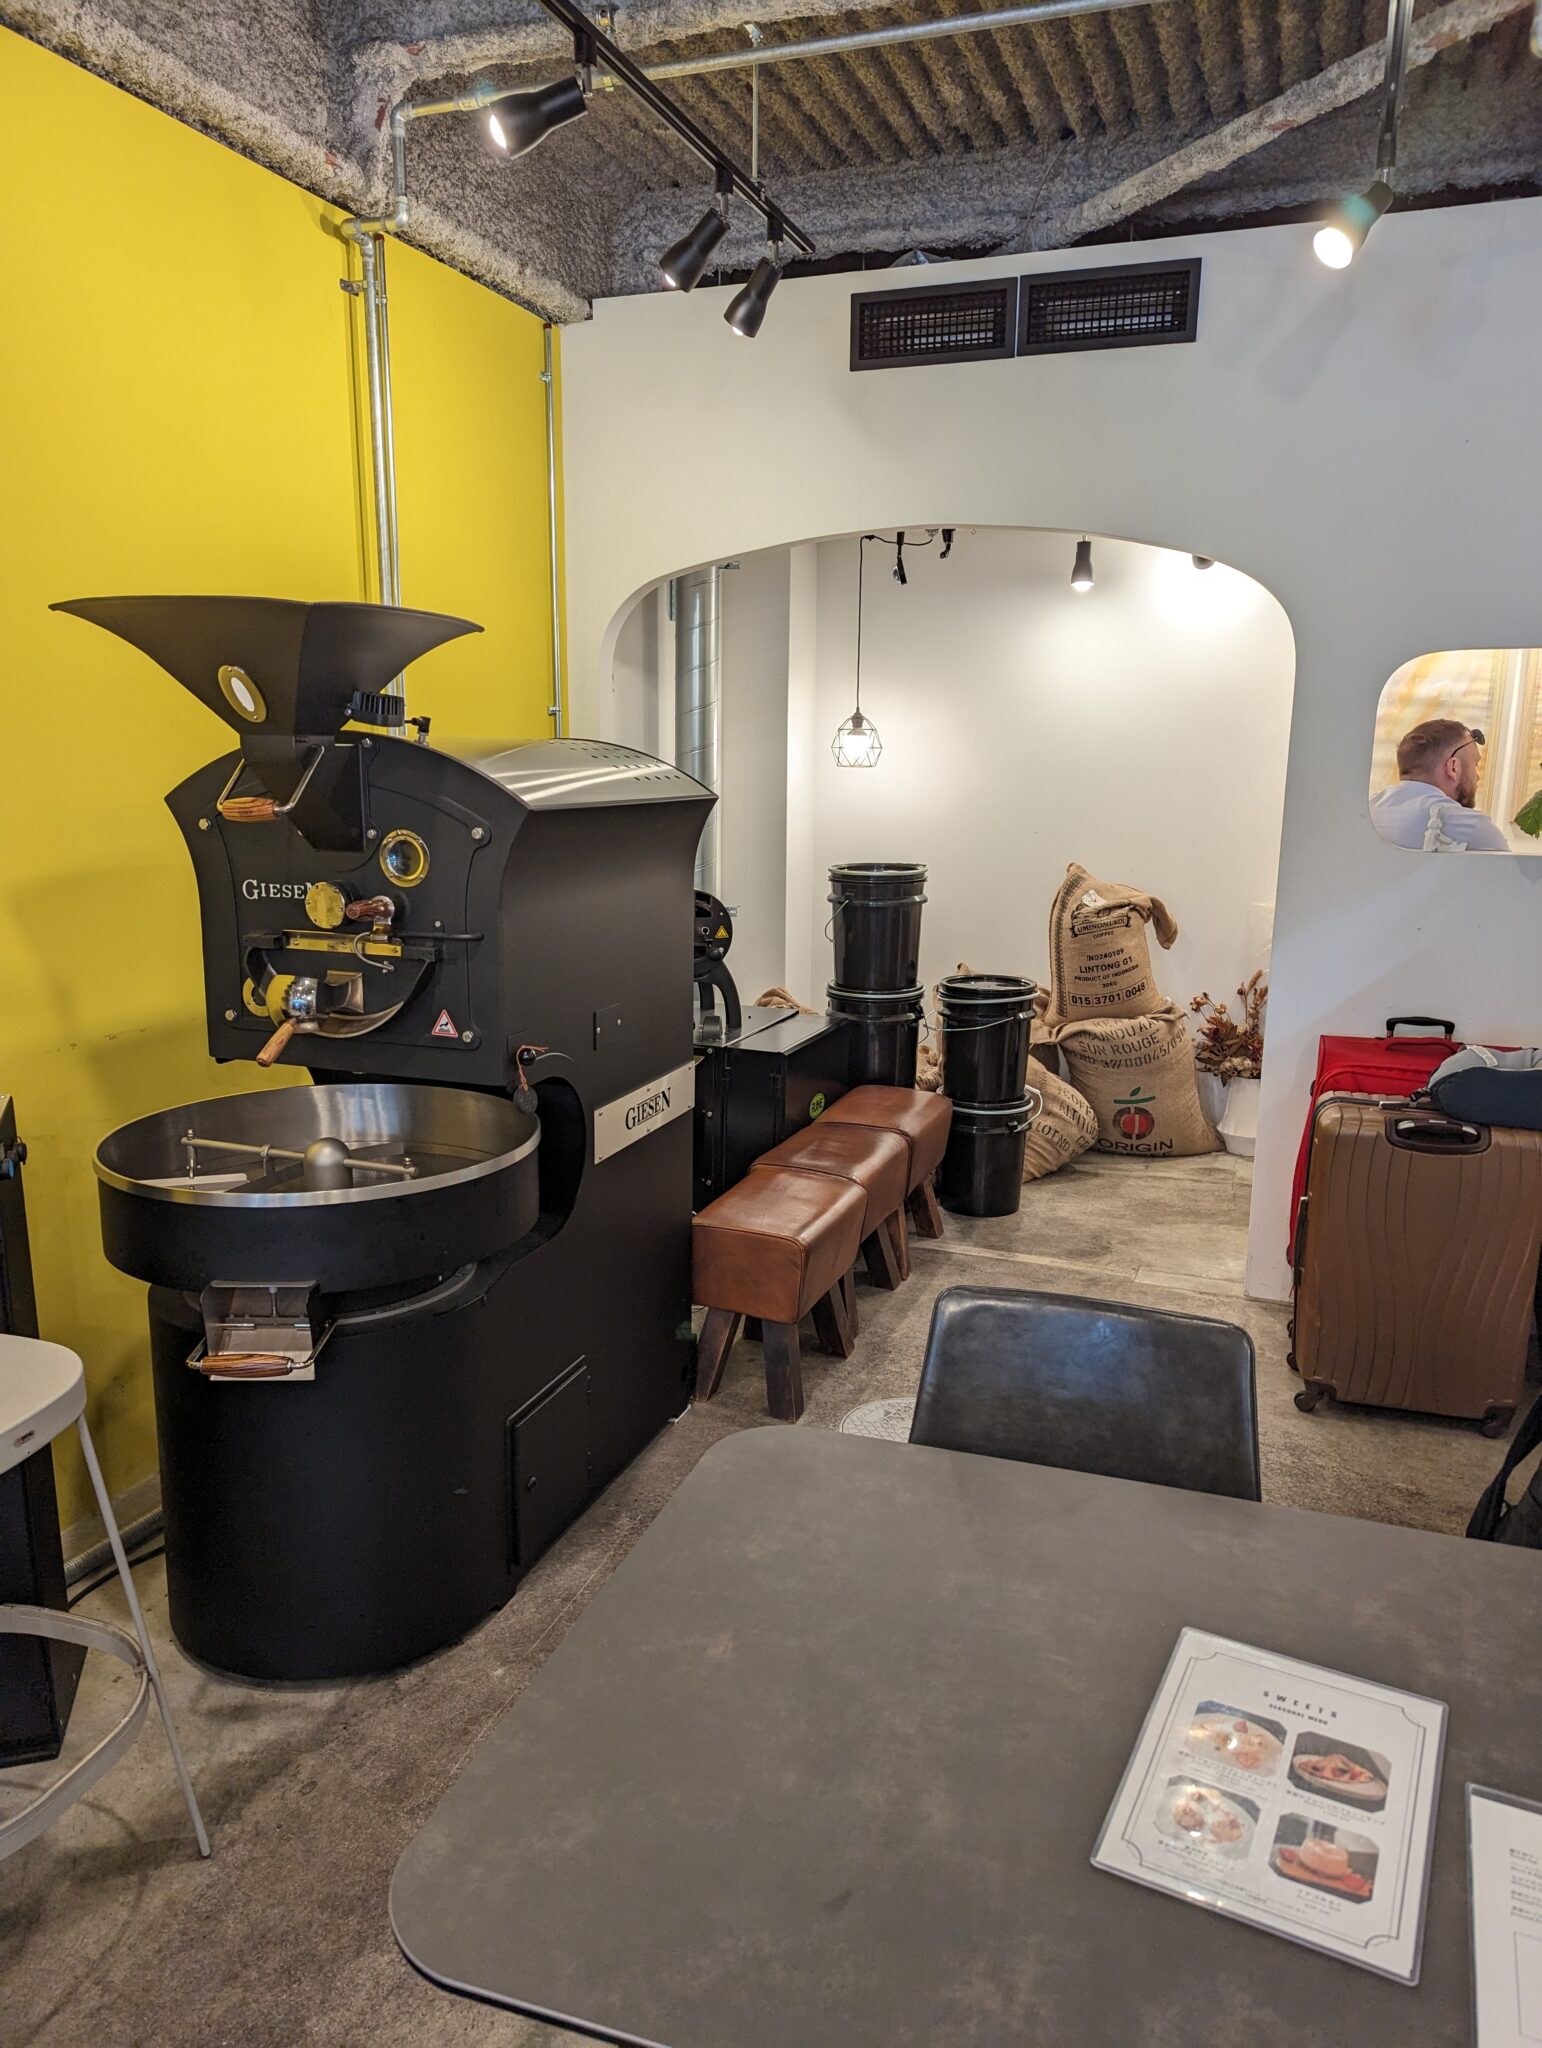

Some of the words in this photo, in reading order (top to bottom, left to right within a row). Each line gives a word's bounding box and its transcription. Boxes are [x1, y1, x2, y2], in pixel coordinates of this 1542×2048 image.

[1093, 930, 1115, 939] COFFEE
[1079, 960, 1121, 974] LINTONG
[1122, 955, 1133, 966] G1
[1111, 963, 1139, 977] INDONESIA
[1071, 995, 1092, 1005] 015
[1094, 992, 1121, 1006] 3701
[1125, 981, 1146, 999] 0048
[1110, 1030, 1161, 1055] ROUGE
[625, 1087, 671, 1130] GIESEN
[1098, 1138, 1174, 1153] ORIGIN
